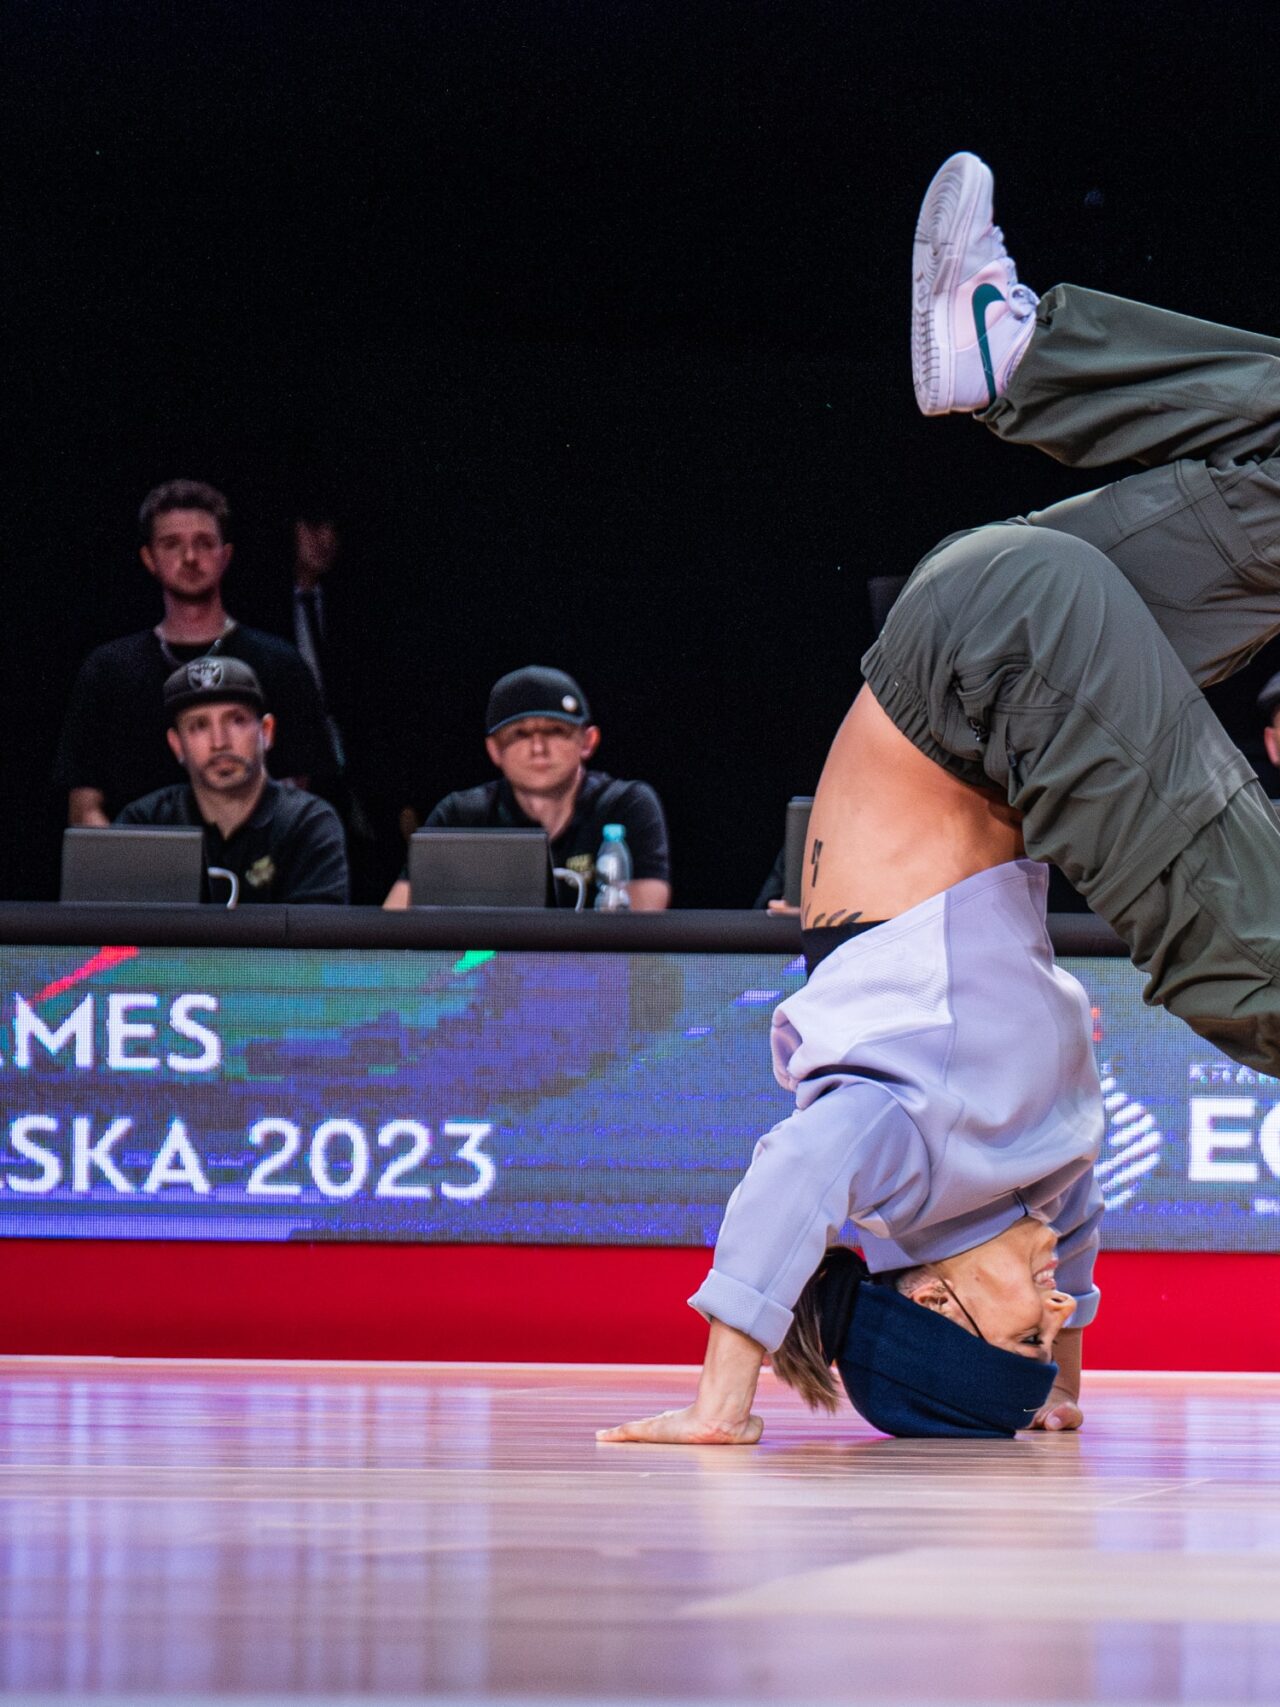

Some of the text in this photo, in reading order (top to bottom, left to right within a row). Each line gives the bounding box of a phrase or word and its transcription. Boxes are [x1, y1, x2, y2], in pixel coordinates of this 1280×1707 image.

[0, 993, 221, 1072] MES
[0, 1115, 498, 1199] SKA 2023
